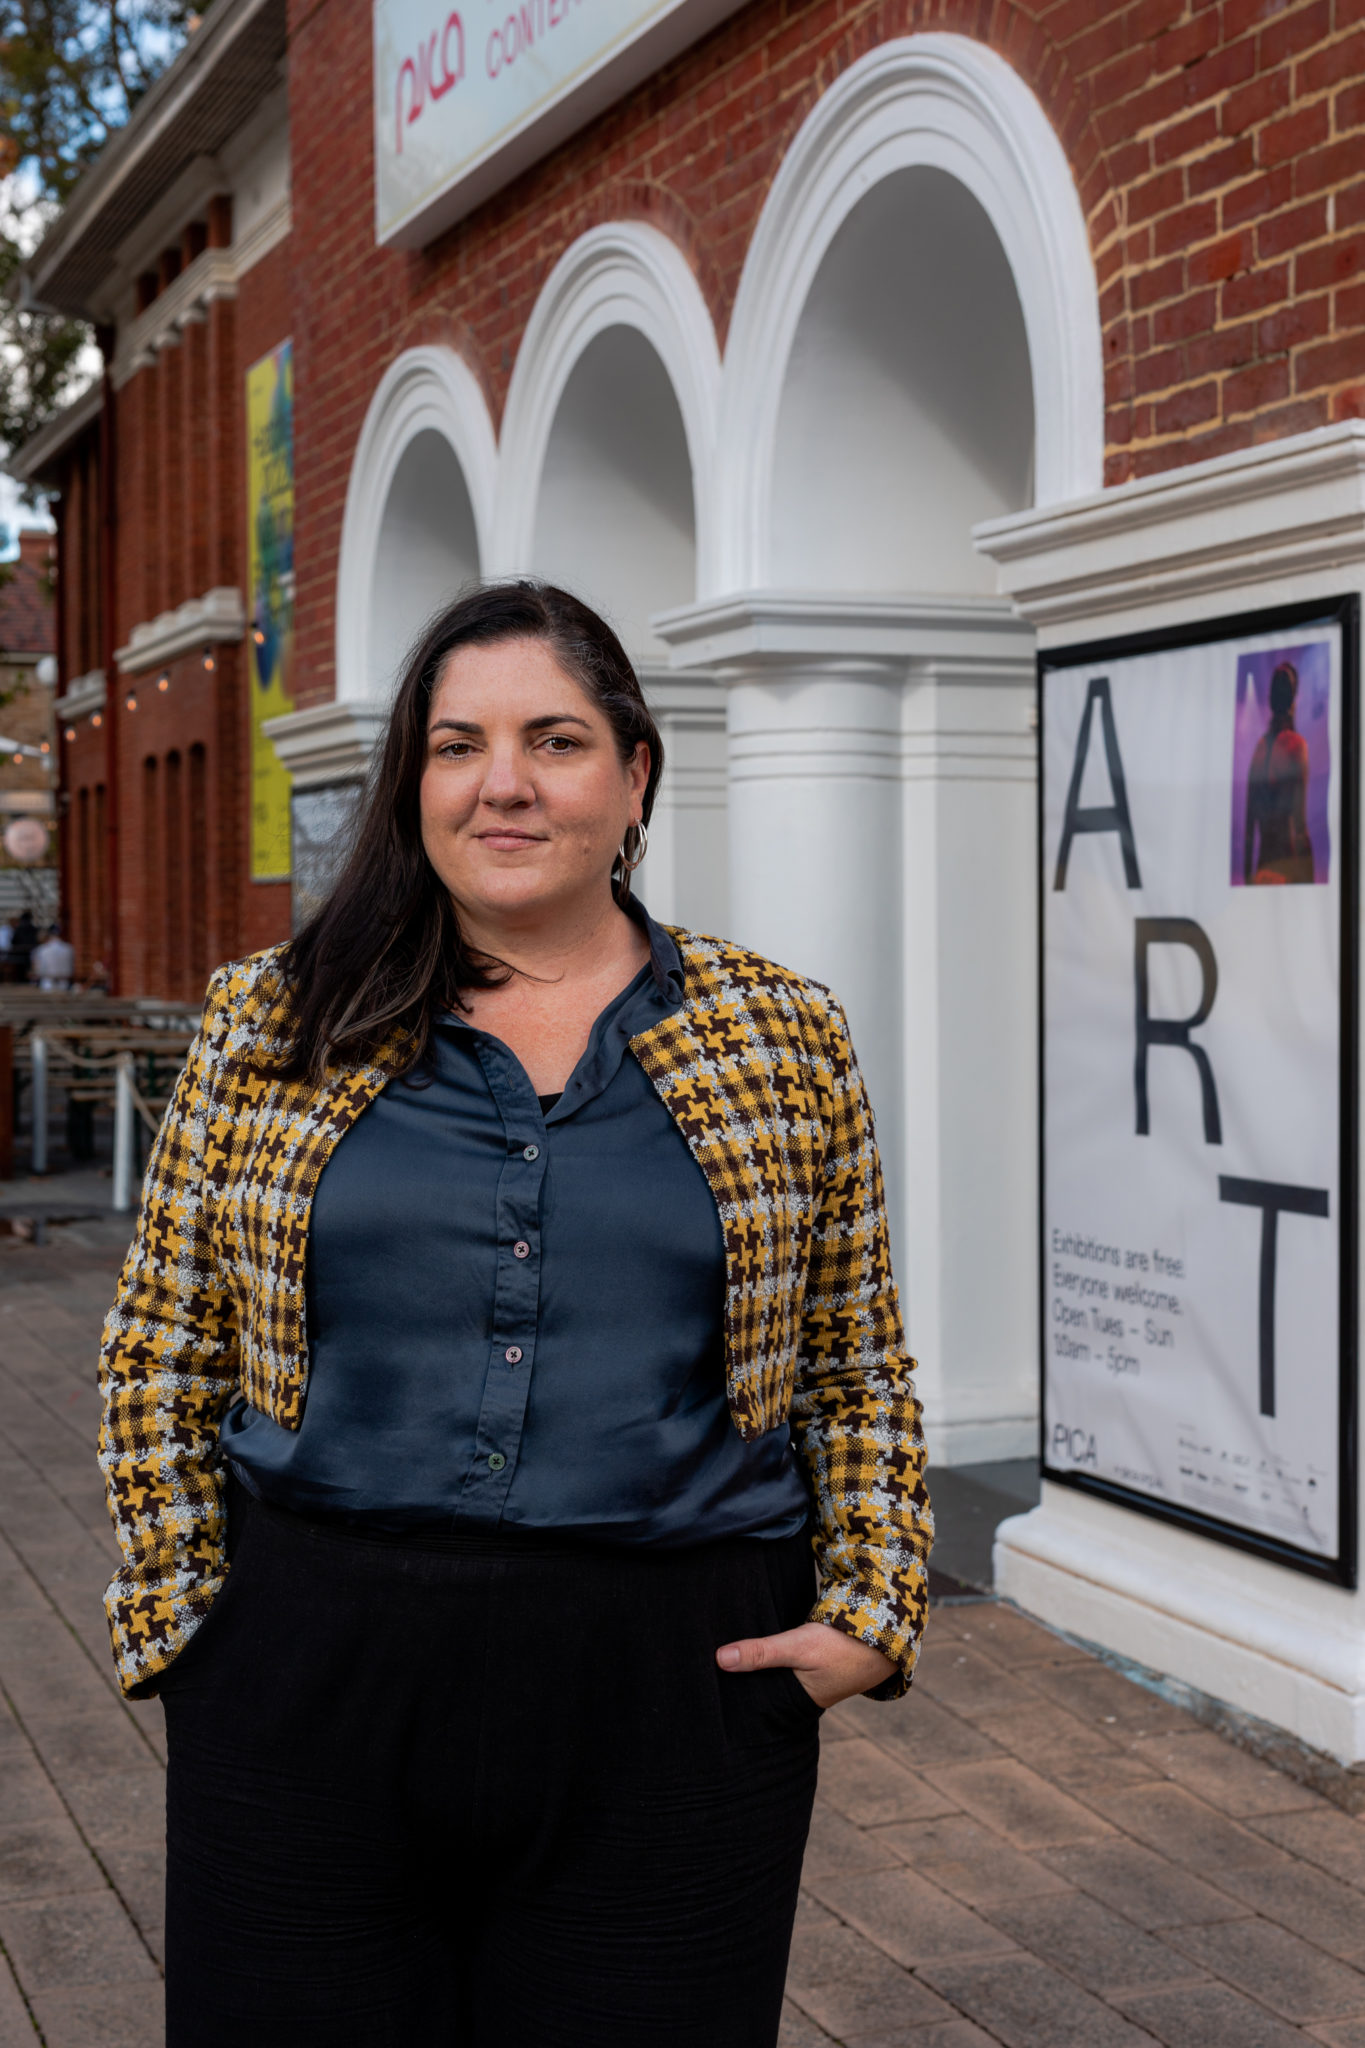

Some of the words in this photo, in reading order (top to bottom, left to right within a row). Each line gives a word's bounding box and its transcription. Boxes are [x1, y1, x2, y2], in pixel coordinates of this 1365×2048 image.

[1053, 1228, 1120, 1267] Exhibitions
[1126, 1250, 1149, 1272] are
[1053, 1262, 1109, 1299] Everyone
[1053, 1297, 1088, 1328] Open
[1090, 1306, 1124, 1338] Tues
[1145, 1318, 1175, 1349] Sun
[1107, 1345, 1141, 1377] 5pm
[1053, 1423, 1097, 1468] PICA
